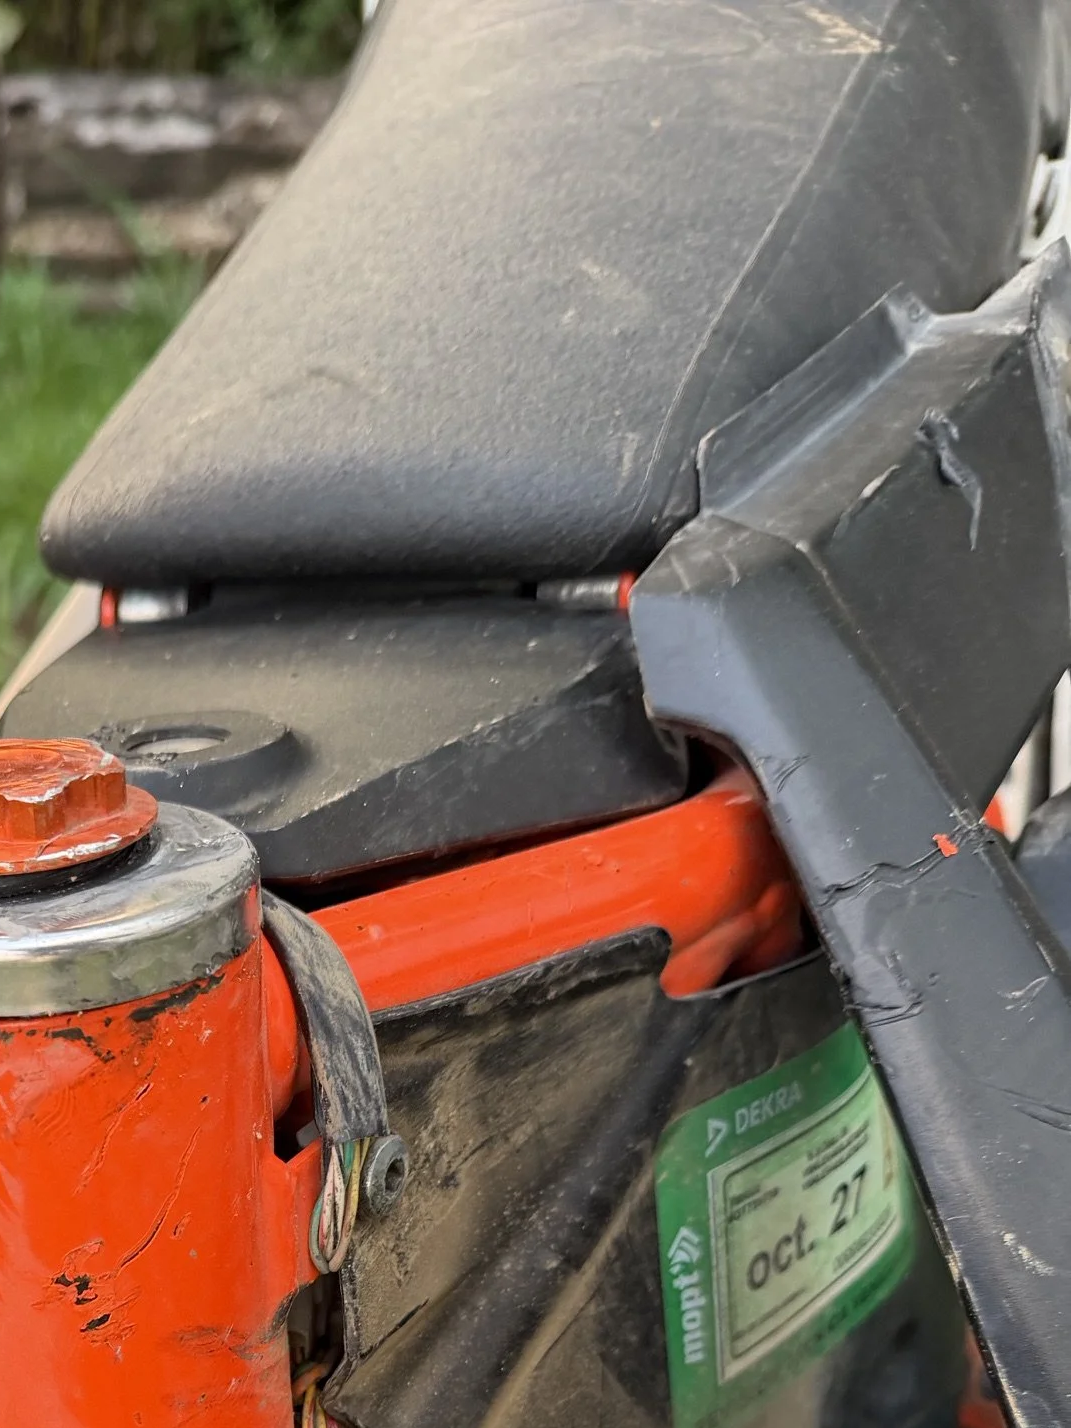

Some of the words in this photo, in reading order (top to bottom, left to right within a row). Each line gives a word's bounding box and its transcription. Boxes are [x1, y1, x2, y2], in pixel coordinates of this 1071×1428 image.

[735, 1080, 803, 1135] DEKRA
[747, 1213, 817, 1291] oct.
[830, 1163, 867, 1236] 27
[673, 1269, 705, 1364] mopt
